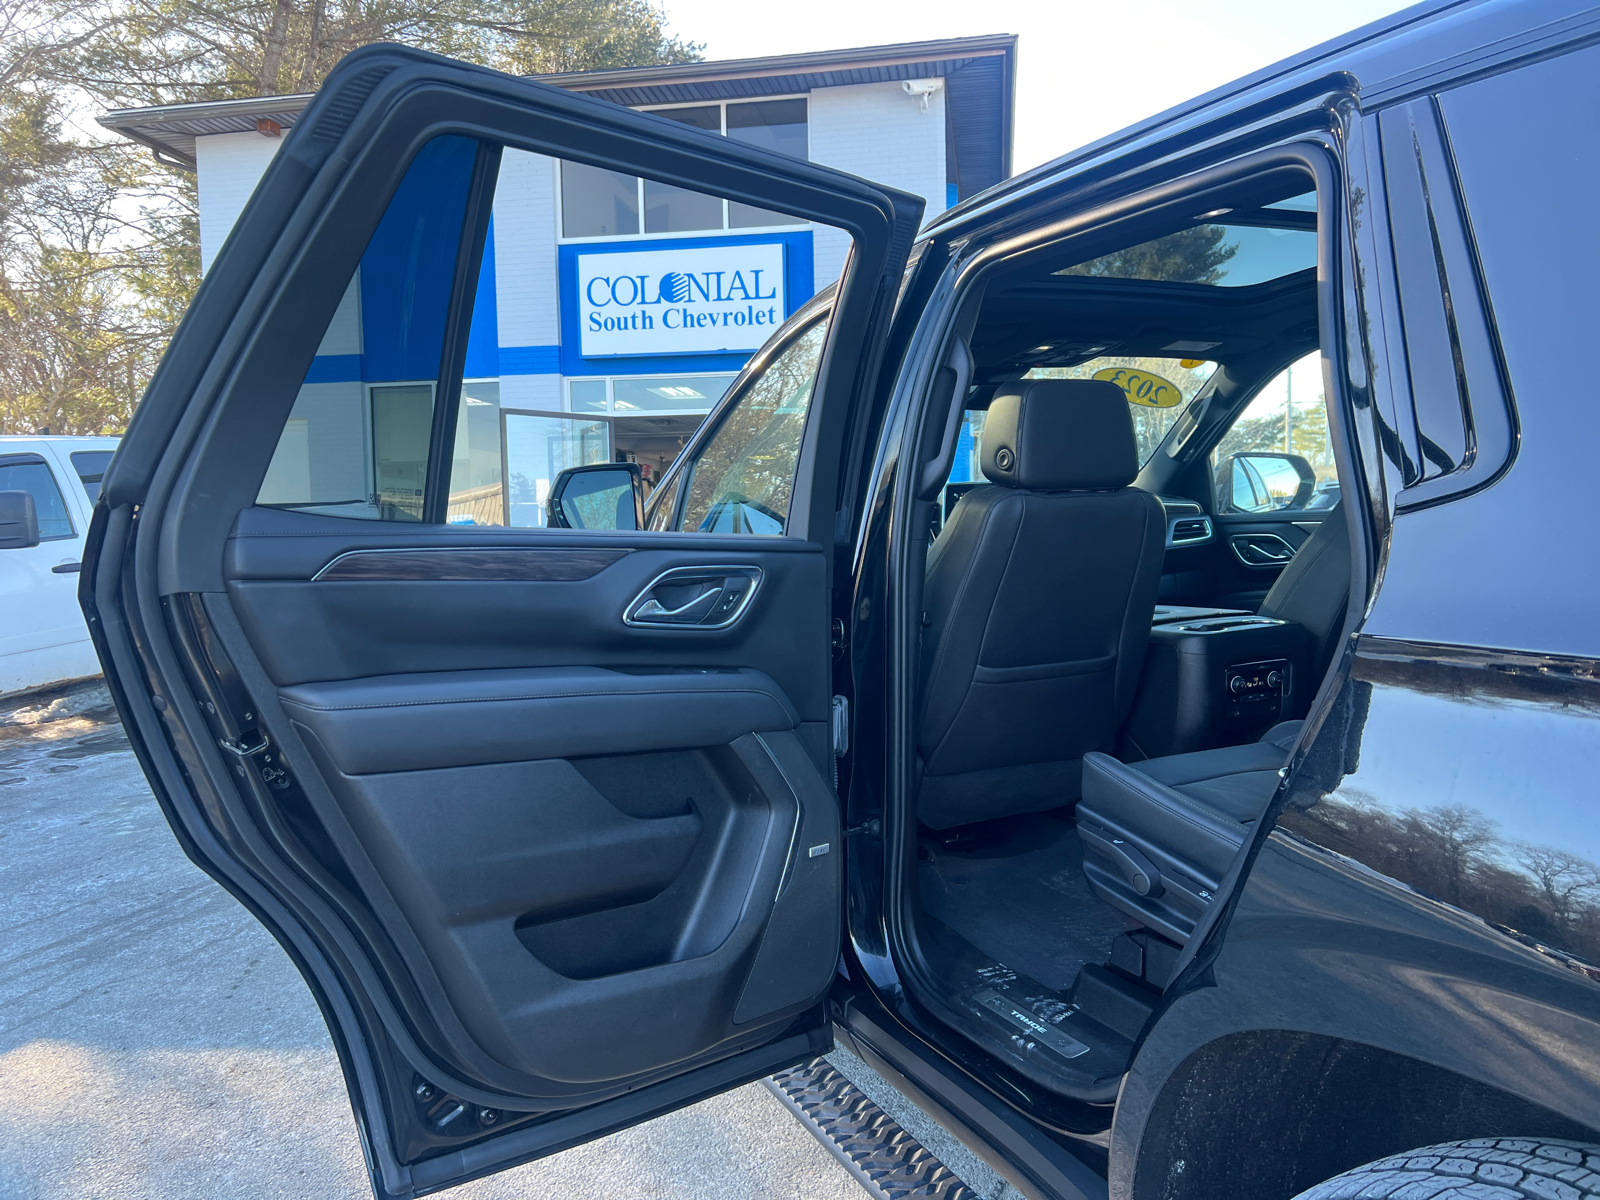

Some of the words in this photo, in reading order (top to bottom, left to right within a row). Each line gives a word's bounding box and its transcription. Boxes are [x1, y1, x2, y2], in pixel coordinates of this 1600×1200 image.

[587, 270, 776, 307] COLONIAL
[589, 310, 654, 332] South
[662, 306, 777, 329] Chevrolet
[1011, 1009, 1047, 1033] TAHOE
